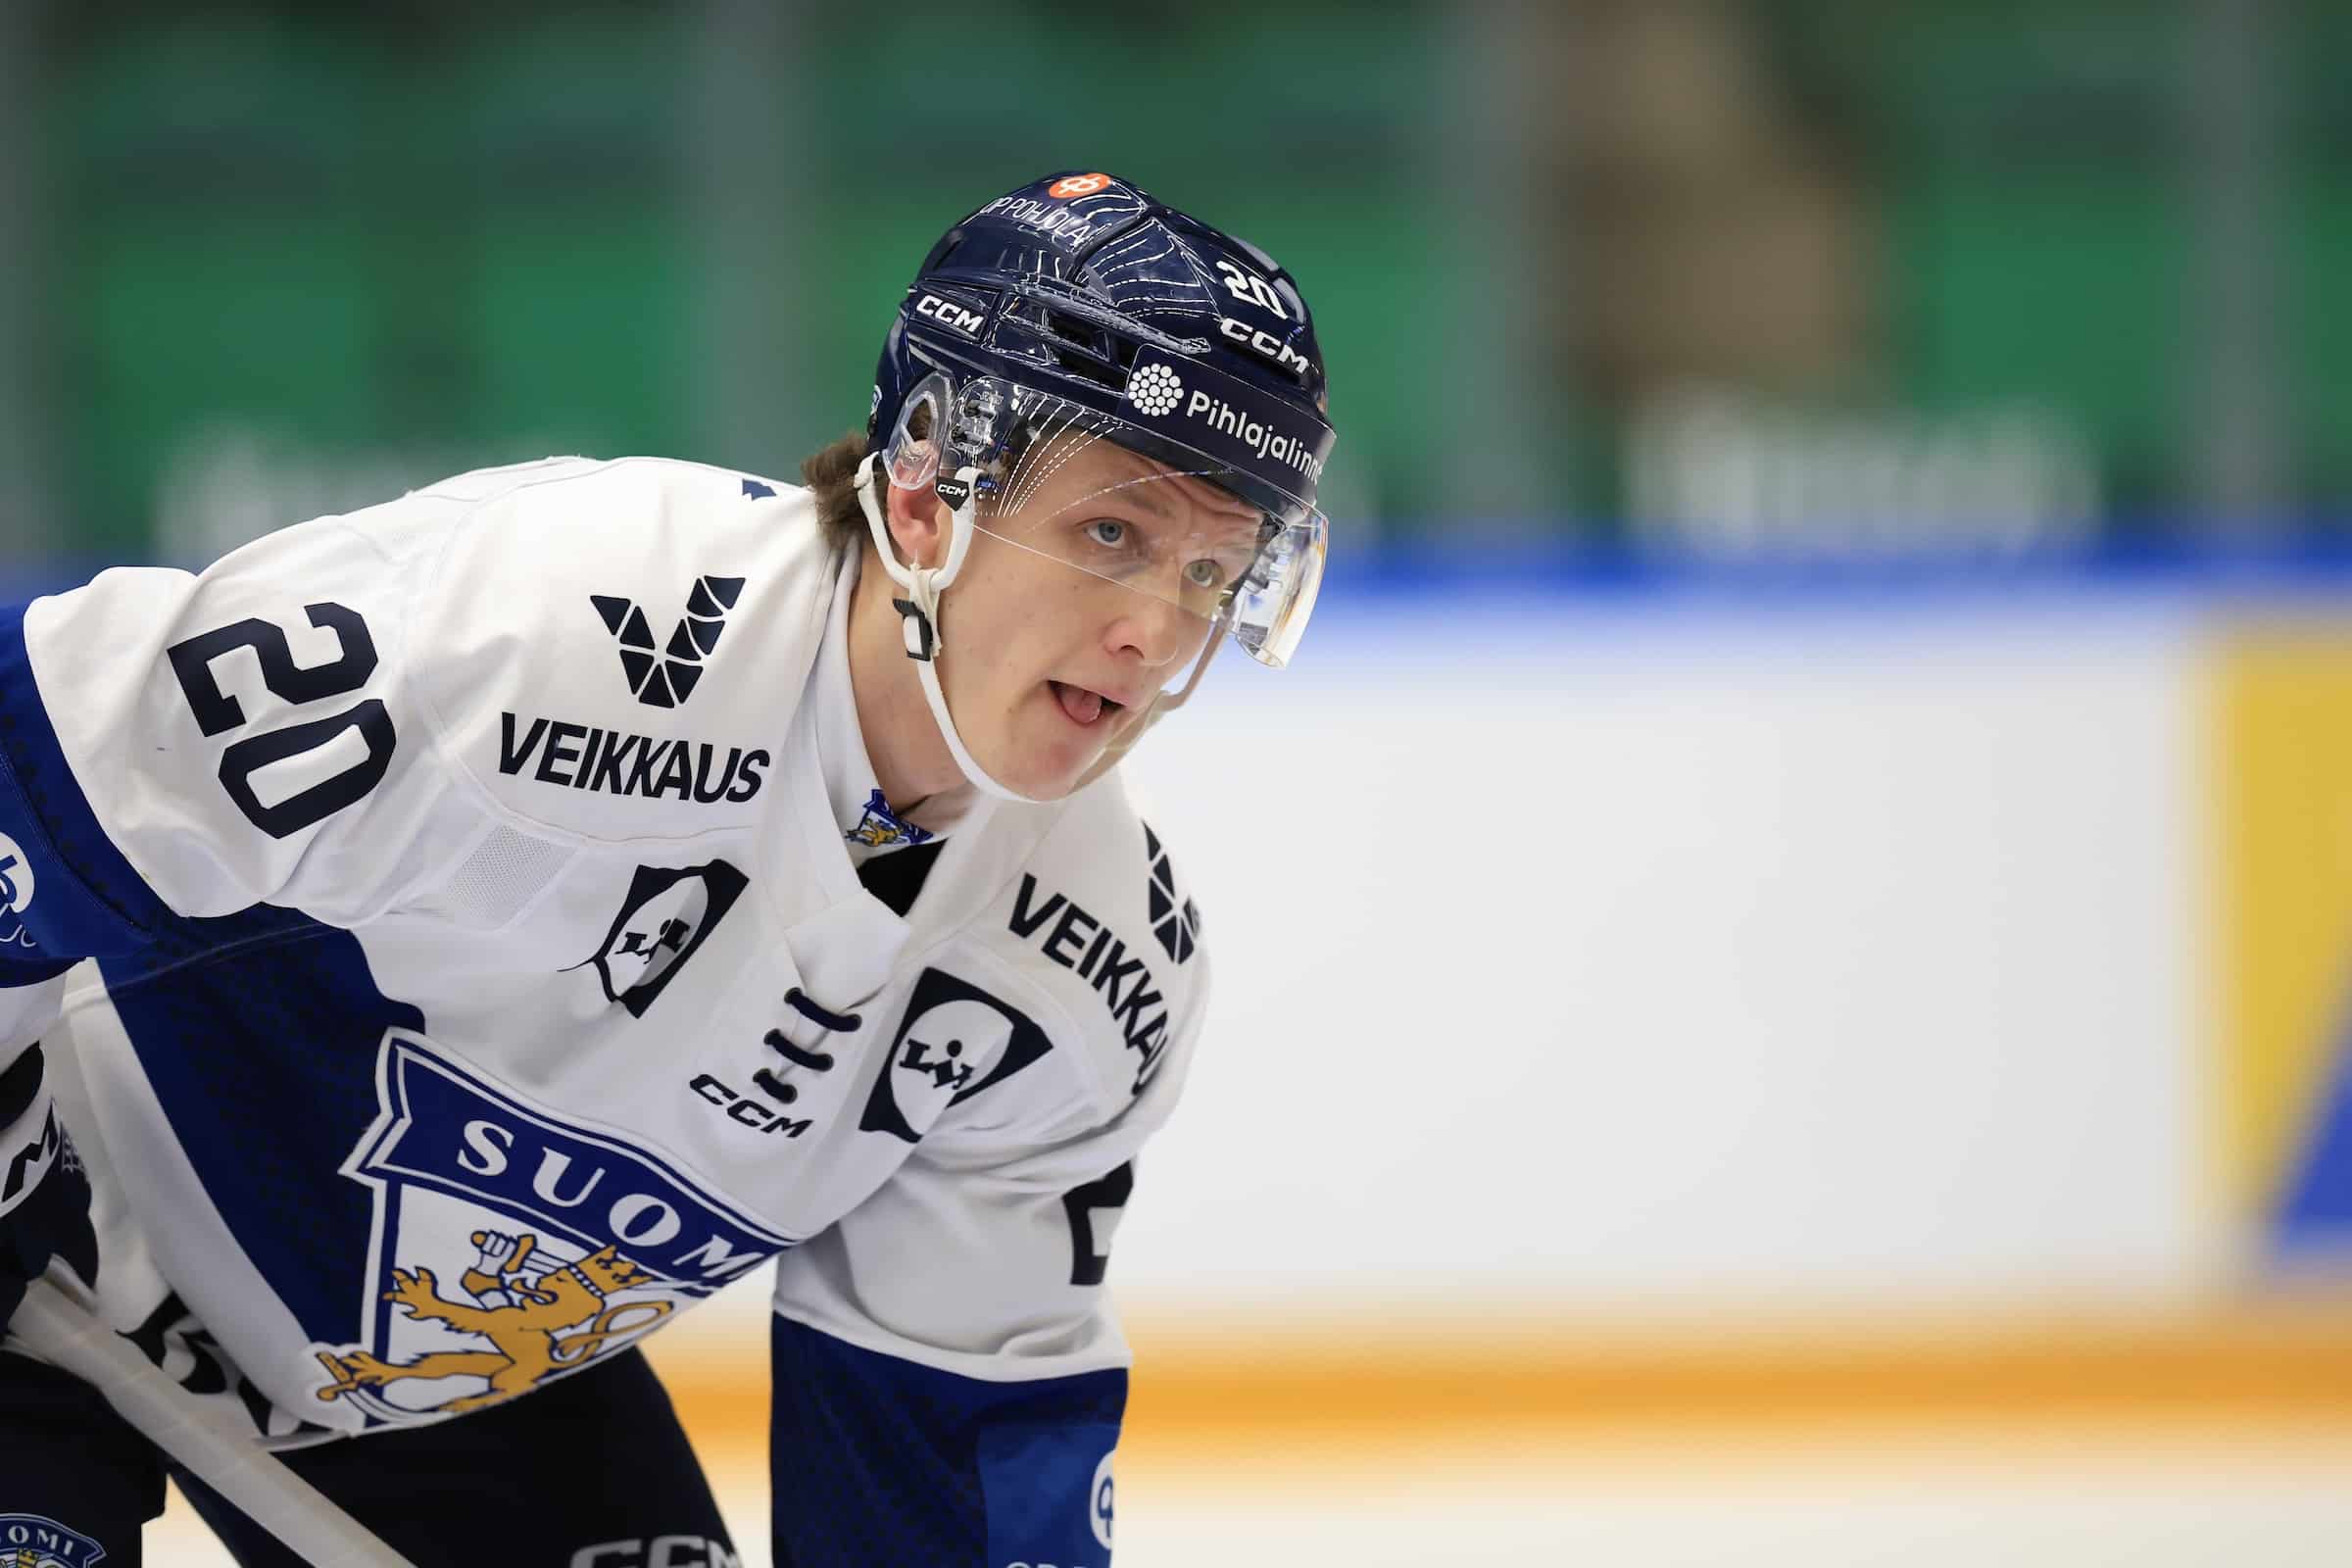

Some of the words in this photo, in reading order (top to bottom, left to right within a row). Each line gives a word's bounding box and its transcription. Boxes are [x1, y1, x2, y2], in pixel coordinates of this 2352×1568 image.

[916, 294, 985, 333] CCM
[1216, 260, 1289, 320] 20
[1220, 317, 1309, 374] CCM
[937, 483, 967, 498] CCM
[167, 601, 397, 840] 20
[500, 711, 770, 804] VEIKKAUS
[689, 1073, 814, 1139] CCM
[0, 1525, 74, 1556] OMI
